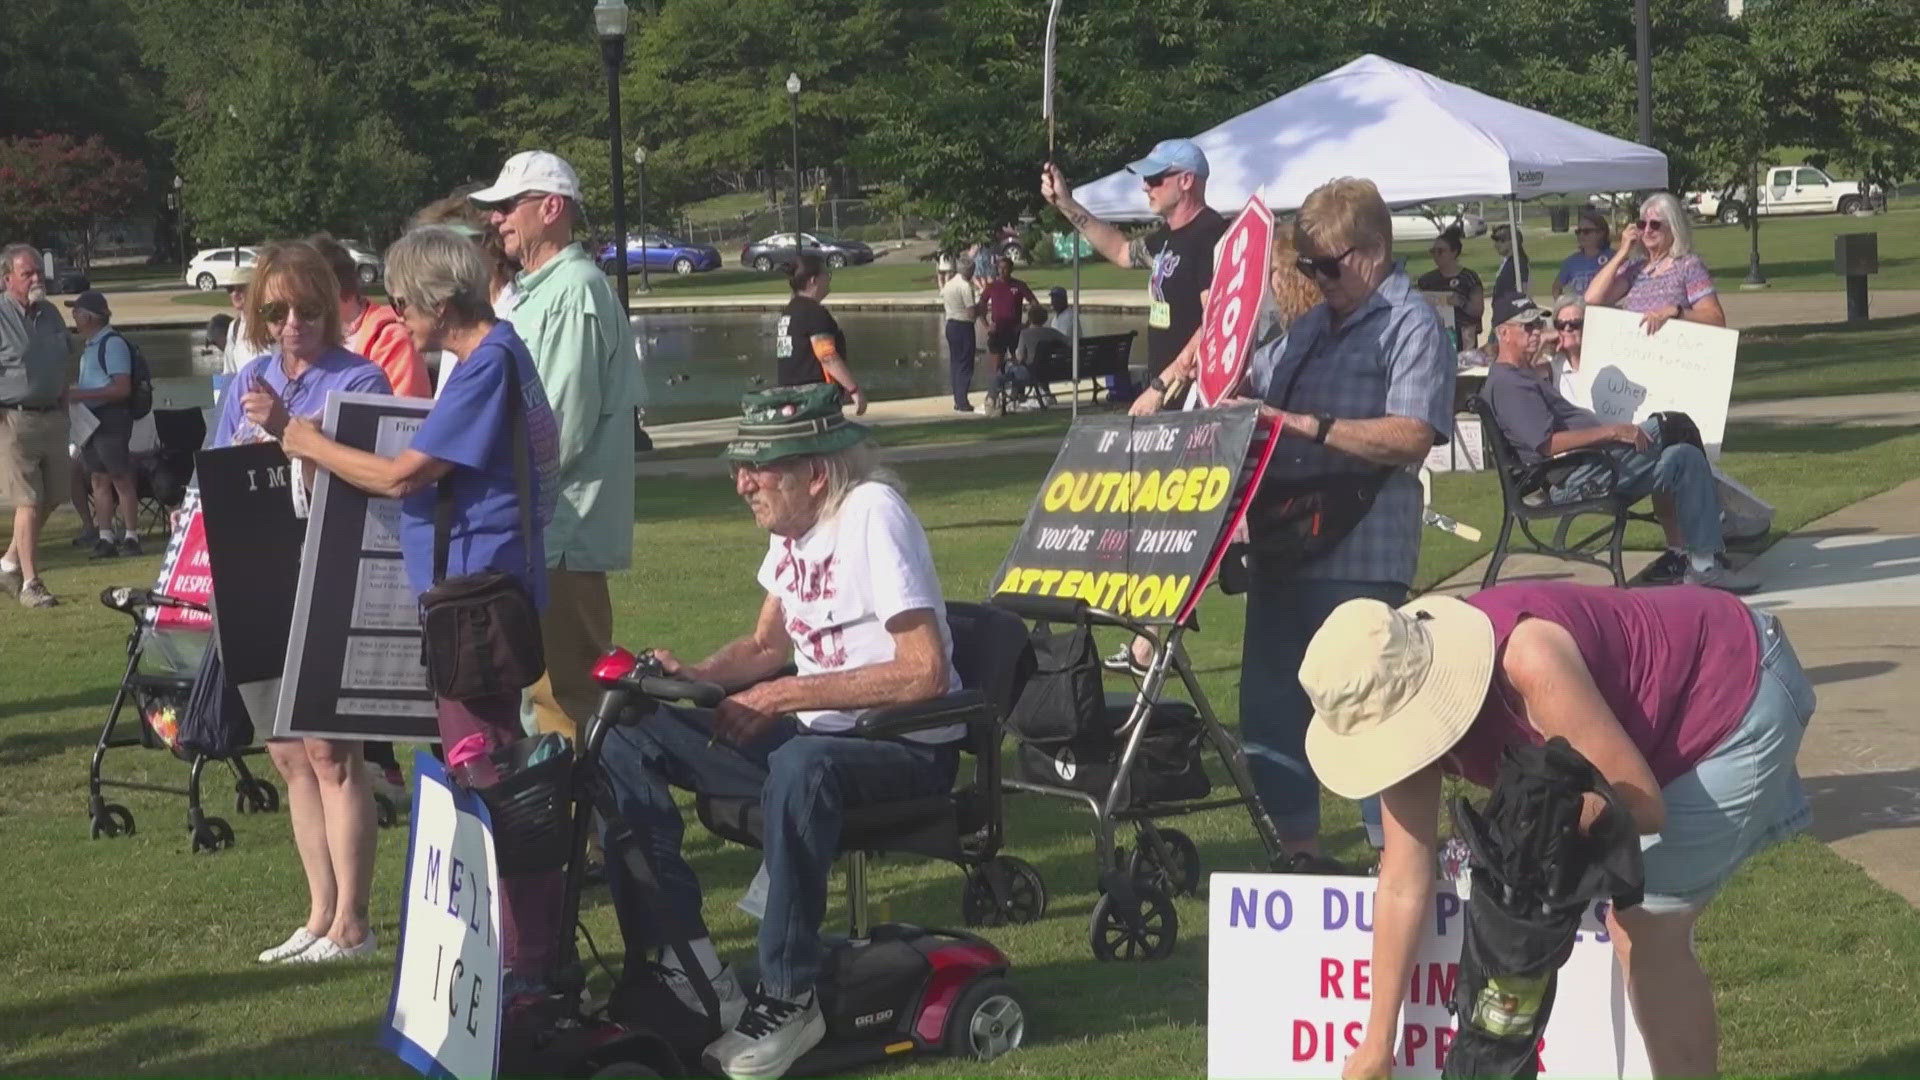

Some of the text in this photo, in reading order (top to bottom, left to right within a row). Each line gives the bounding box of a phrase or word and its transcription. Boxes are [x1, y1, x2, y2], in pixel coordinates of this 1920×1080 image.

[1516, 169, 1545, 185] Academy
[1220, 226, 1249, 375] STOP
[1602, 399, 1626, 416] Our
[1097, 424, 1222, 453] IF YOU'RE NOT
[1044, 465, 1232, 513] OUTRAGED
[1036, 525, 1197, 553] YOU'RE NOT PAYING
[174, 574, 213, 594] RESPEC
[995, 566, 1192, 618] ATTENTION
[424, 845, 493, 947] MELT
[1229, 886, 1294, 931] NO
[432, 944, 482, 1038] ICE
[1320, 957, 1460, 1006] REIM
